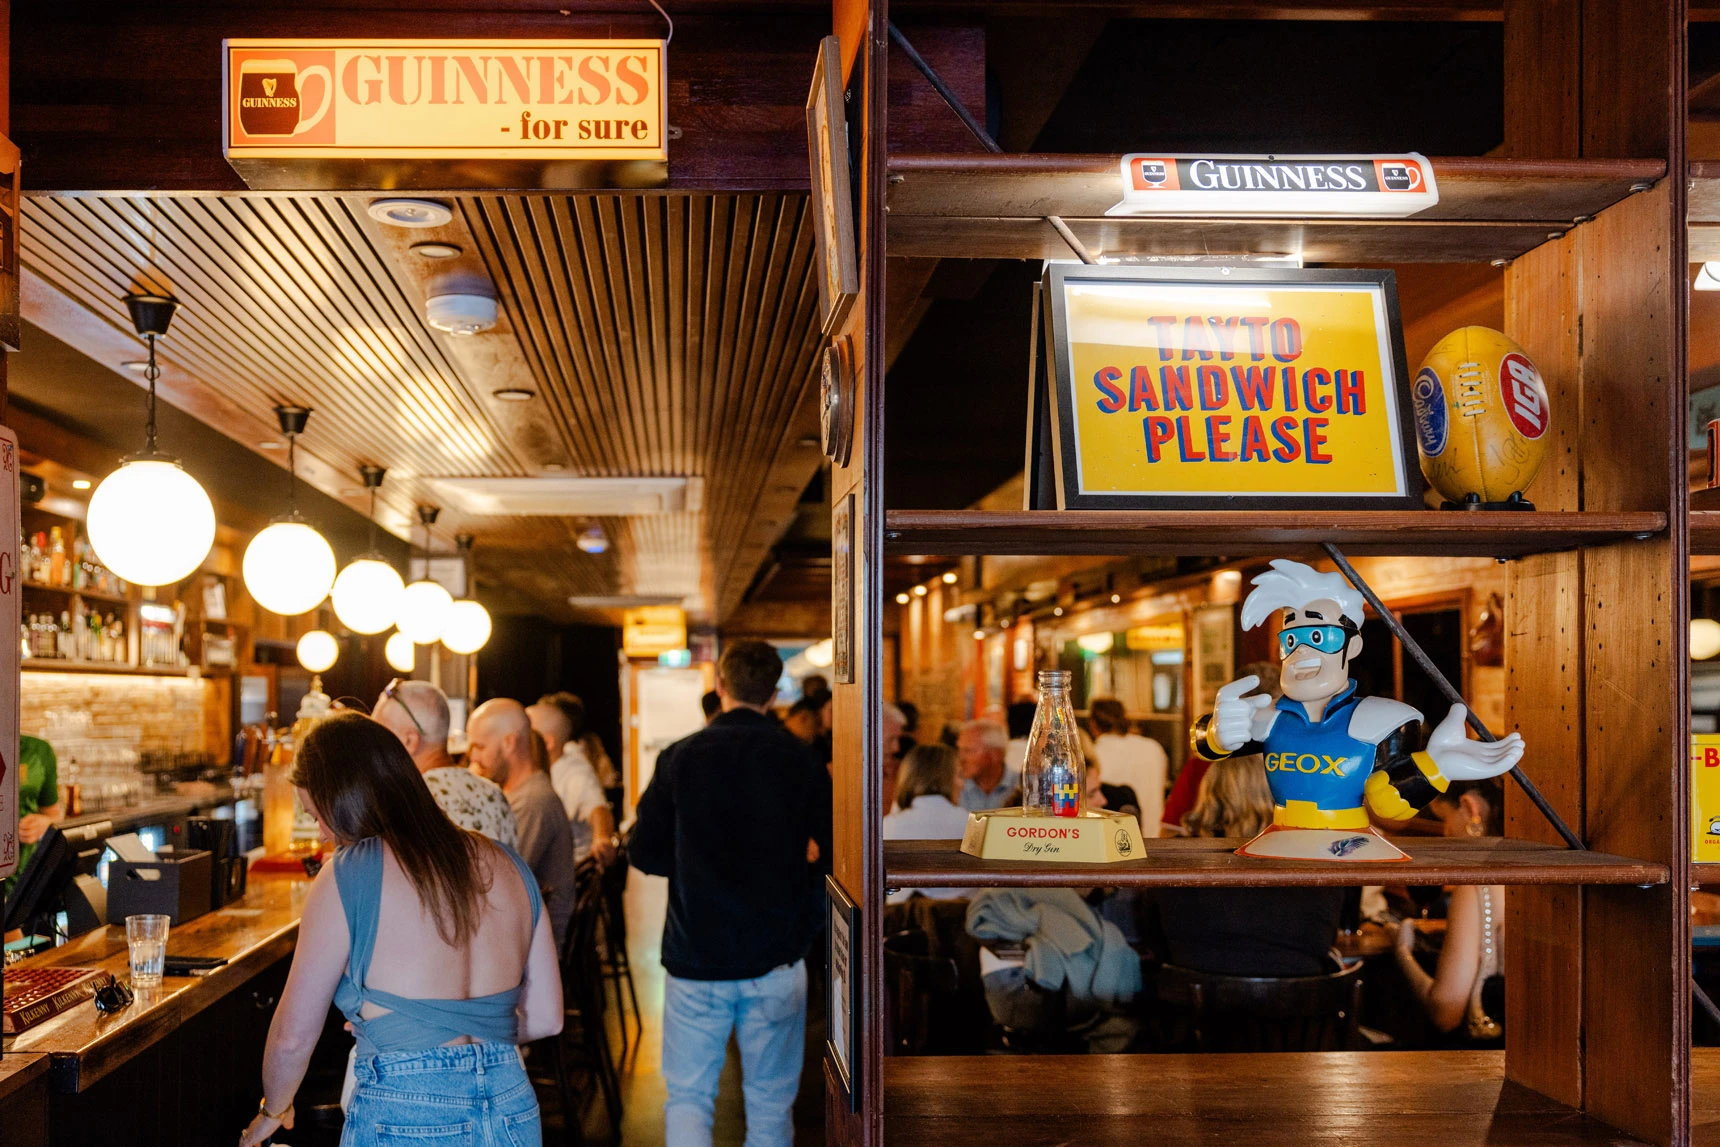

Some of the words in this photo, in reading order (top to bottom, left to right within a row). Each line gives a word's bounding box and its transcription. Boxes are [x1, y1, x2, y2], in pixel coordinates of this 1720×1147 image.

[342, 55, 650, 105] GUINNESS
[242, 97, 297, 109] GUINNESS
[519, 111, 568, 141] for
[578, 117, 649, 141] sure
[1189, 160, 1367, 190] GUINNESS
[1147, 315, 1303, 363] TAYTO
[1093, 365, 1367, 415] SANDWICH
[1507, 359, 1541, 430] IGA
[1142, 415, 1333, 464] PLEASE
[1265, 752, 1349, 777] GEOX
[1006, 827, 1080, 840] GORDON'S
[1023, 842, 1043, 856] Dry
[1043, 842, 1061, 854] Gin
[20, 1003, 50, 1025] KILKENNY
[52, 991, 81, 1010] KILKENNY
